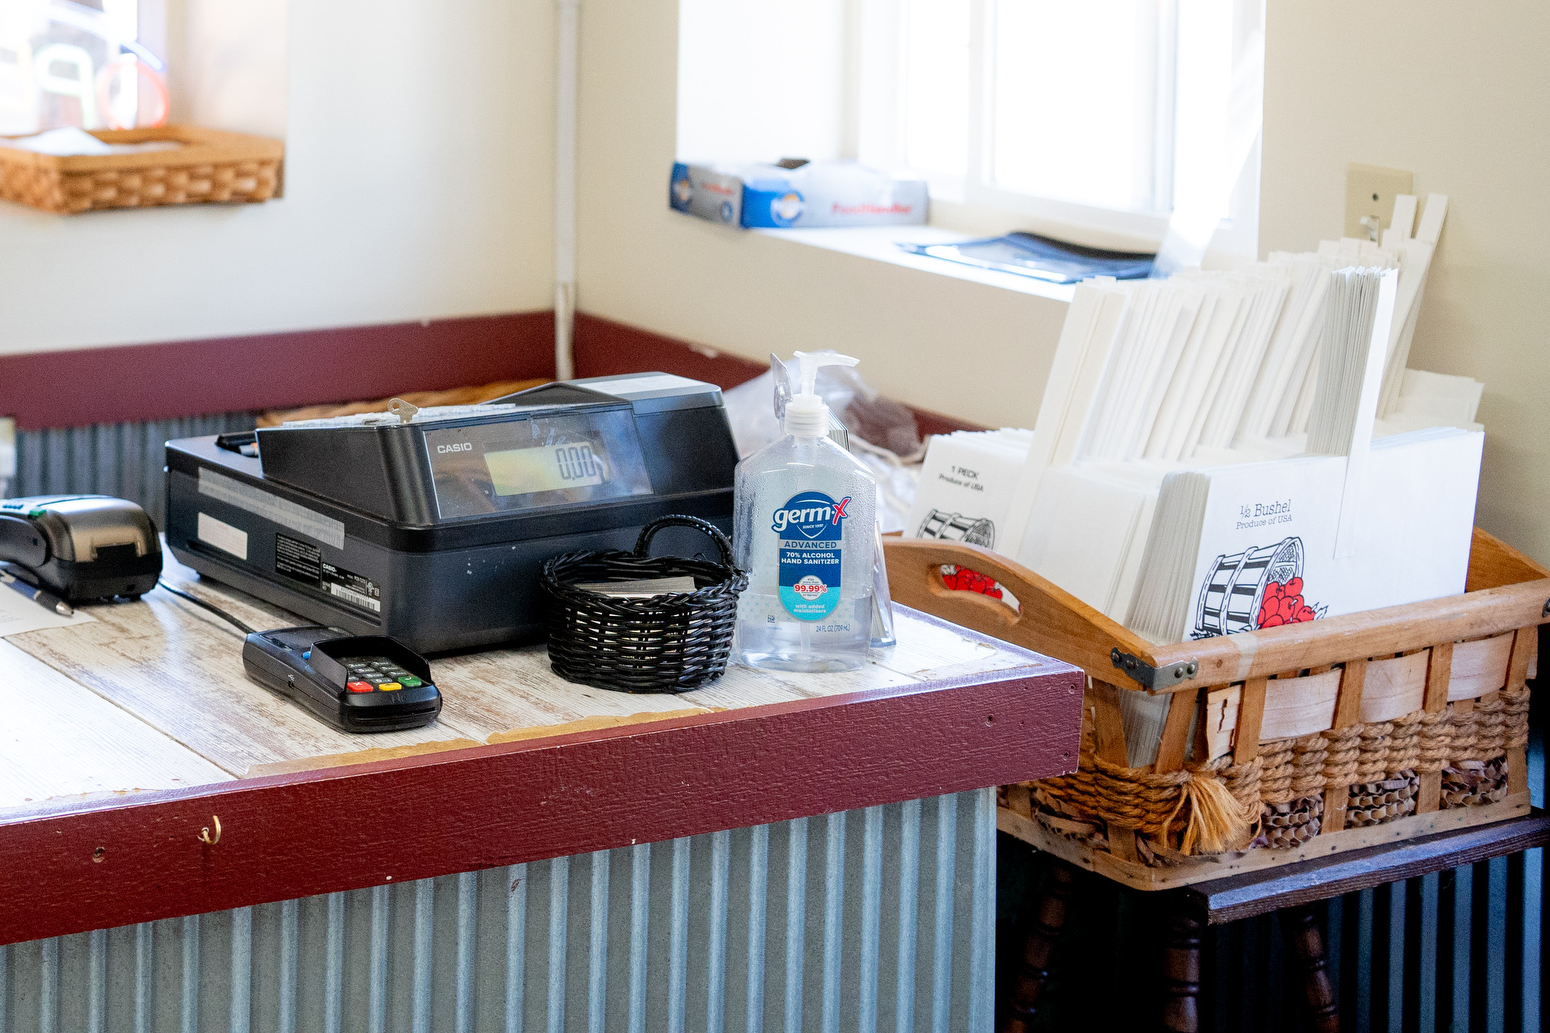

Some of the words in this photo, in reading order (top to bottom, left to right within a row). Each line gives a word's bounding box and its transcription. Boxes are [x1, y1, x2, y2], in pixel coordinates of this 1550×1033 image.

[437, 442, 472, 454] CASIO
[556, 445, 597, 481] 0.00
[939, 473, 962, 486] Produce
[958, 467, 979, 480] PECK
[1253, 498, 1292, 518] Bushel
[1236, 519, 1267, 530] Produce
[1268, 516, 1277, 525] of
[1277, 514, 1293, 524] USA
[784, 541, 837, 549] ADVANCED
[794, 584, 827, 593] 99.99%
